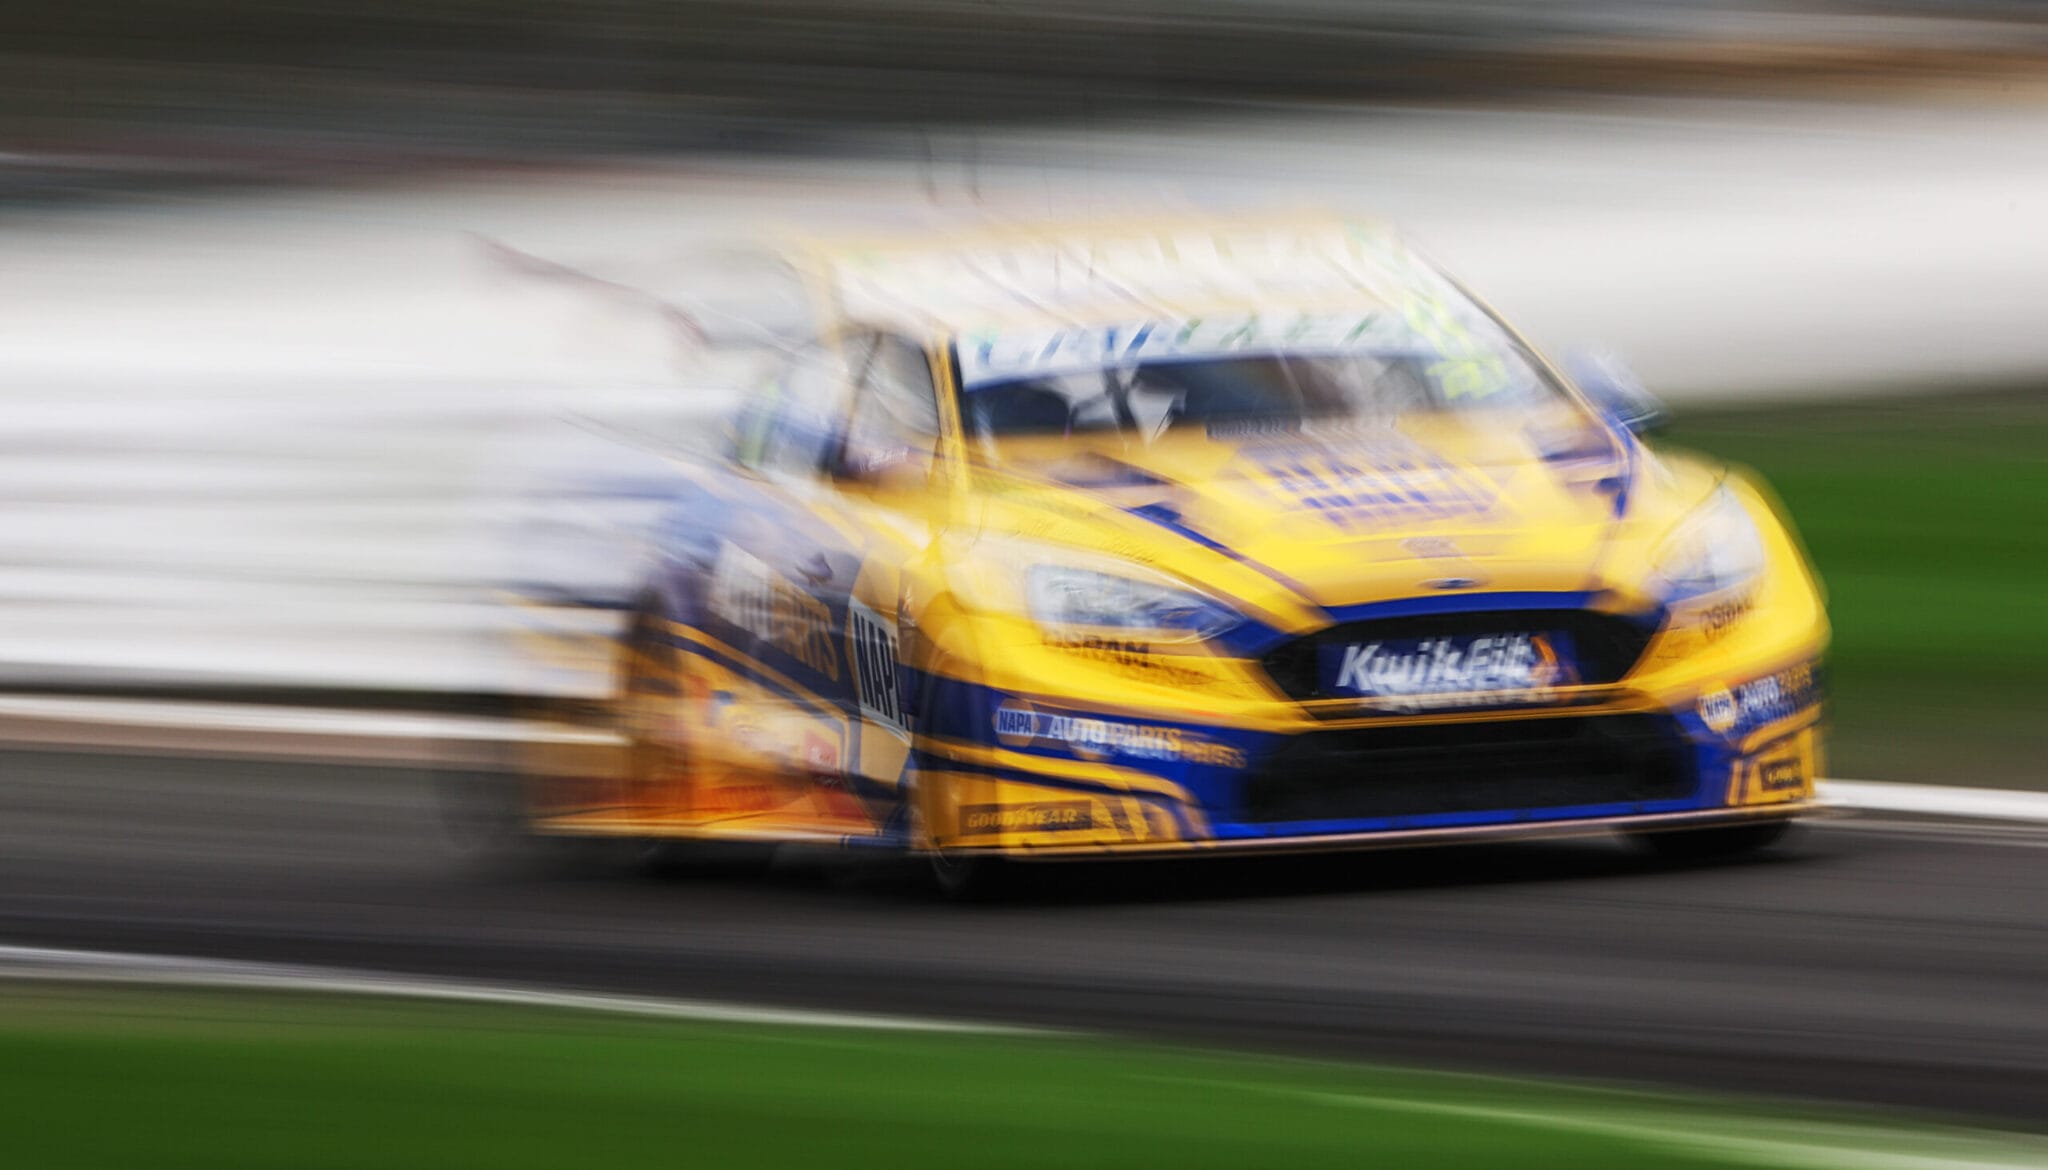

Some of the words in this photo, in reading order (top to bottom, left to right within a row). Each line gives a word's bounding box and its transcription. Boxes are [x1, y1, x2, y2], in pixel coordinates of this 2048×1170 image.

[999, 709, 1033, 733] NAPA
[1050, 715, 1107, 742] AUTO
[1109, 722, 1182, 752] PARTS
[967, 805, 1078, 828] GOODYEAR
